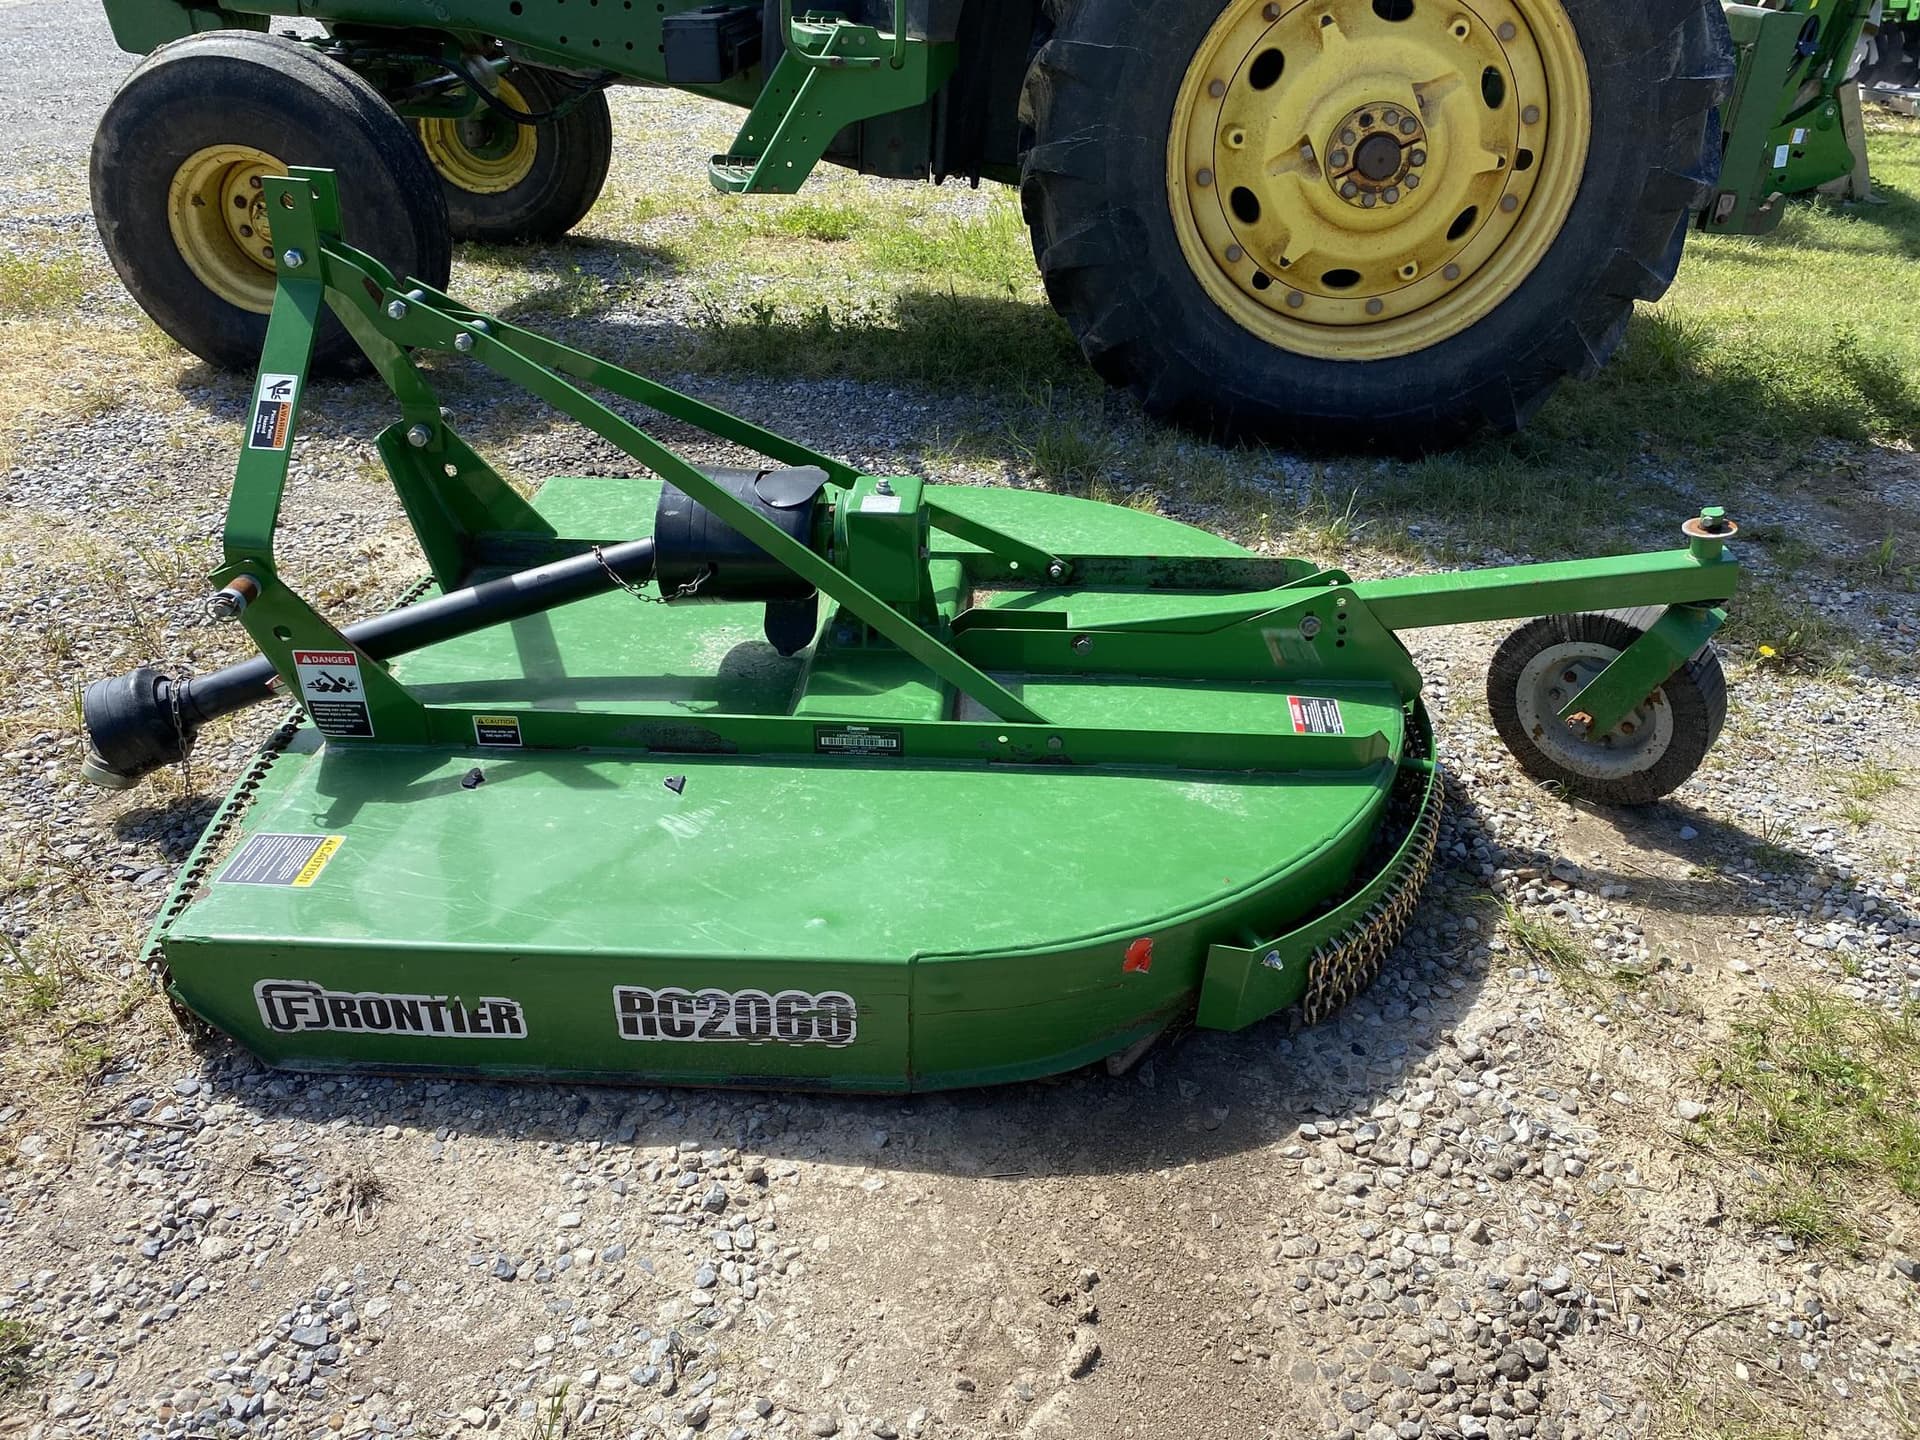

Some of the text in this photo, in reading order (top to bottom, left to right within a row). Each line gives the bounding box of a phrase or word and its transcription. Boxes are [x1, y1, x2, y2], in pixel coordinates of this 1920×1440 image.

[275, 409, 288, 445] WARNING
[311, 655, 351, 664] DANGER
[298, 846, 332, 883] CAUTION
[256, 981, 525, 1037] FRONTIER
[615, 987, 856, 1044] RC2060
